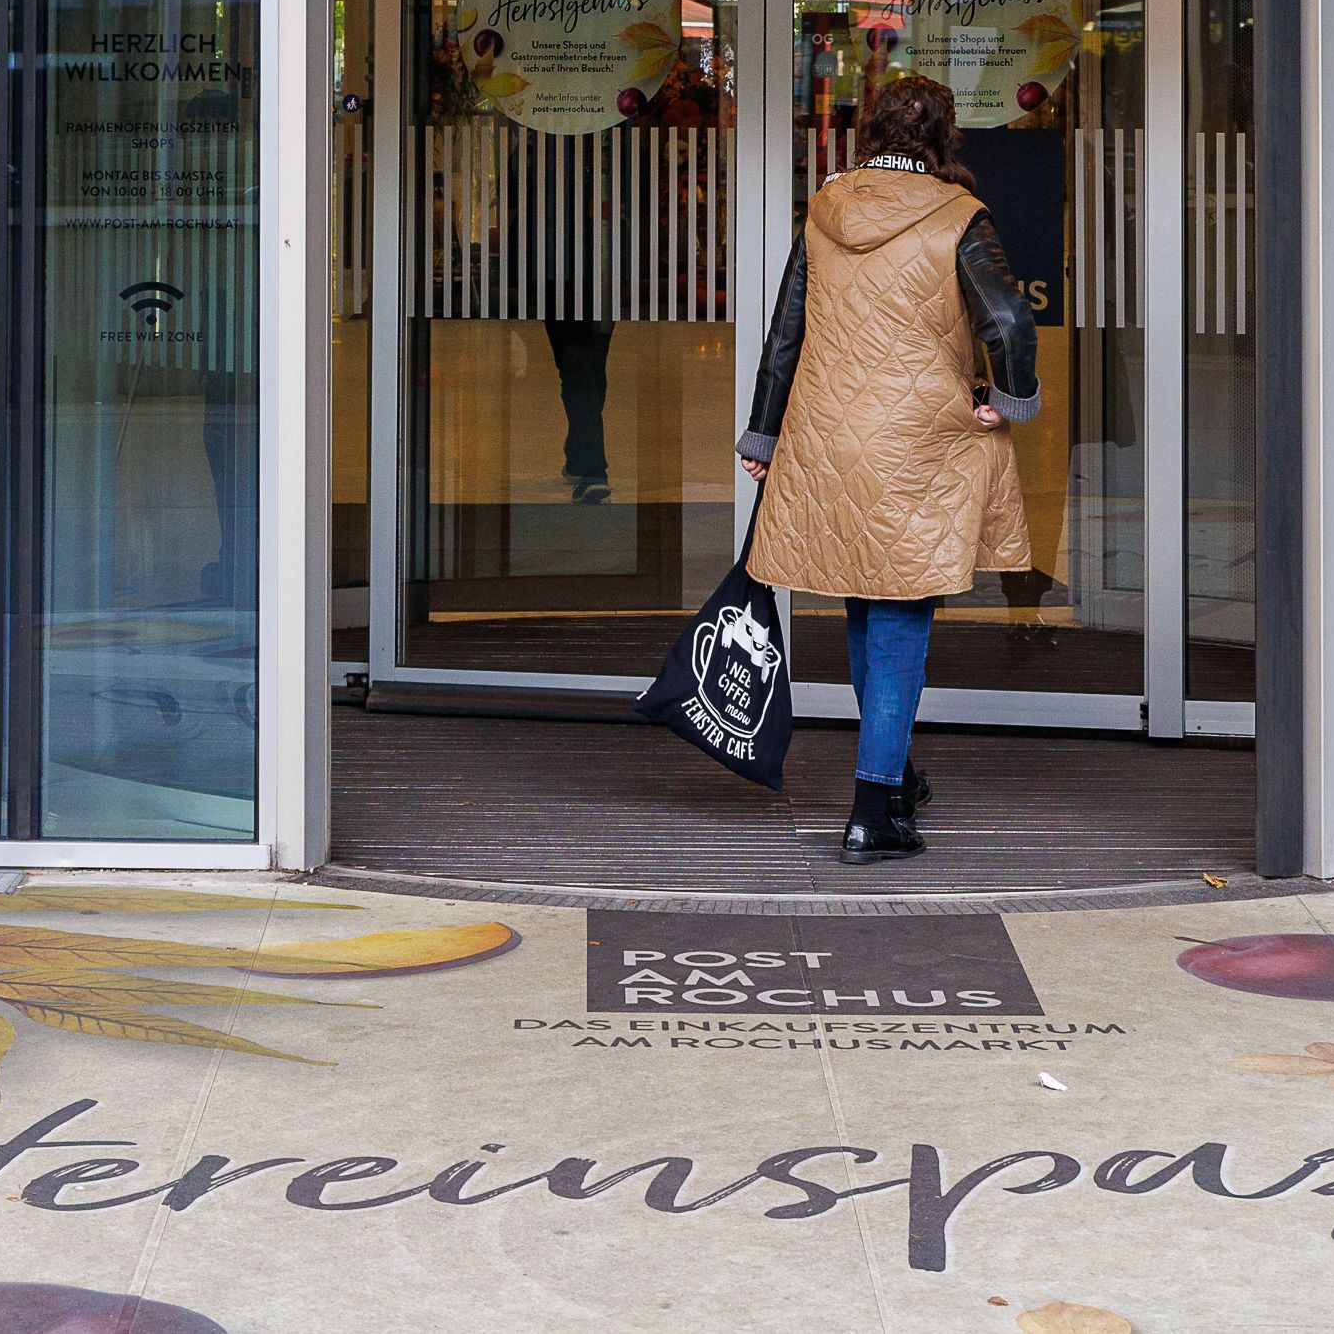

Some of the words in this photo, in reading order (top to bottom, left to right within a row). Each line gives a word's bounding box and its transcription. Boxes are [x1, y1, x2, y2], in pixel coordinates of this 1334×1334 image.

[90, 34, 216, 54] HERZLICH
[531, 41, 560, 50] Unsere
[563, 40, 587, 52] Shops
[589, 40, 606, 50] und
[927, 34, 957, 44] Unsere
[959, 34, 985, 46] Shops
[987, 34, 1005, 44] und
[905, 45, 996, 56] Gastronomiebetriebe
[998, 46, 1027, 56] freuen
[511, 52, 597, 62] Gastronomiebetriebe
[599, 52, 627, 62] freuen
[918, 57, 936, 68] sich
[938, 57, 952, 68] auf
[954, 57, 977, 68] Ihren
[979, 57, 1014, 68] Besuch!
[65, 62, 241, 82] WILLKOMMEN
[523, 63, 540, 73] sich
[542, 63, 555, 73] auf
[557, 63, 579, 73] Ihren
[581, 63, 614, 73] Besuch!
[536, 92, 556, 102] Mehr
[559, 92, 578, 102] Infos
[580, 93, 602, 102] unter
[956, 87, 977, 98] Infos
[978, 88, 1002, 98] unter
[532, 104, 605, 115] post-am-rochus.at
[954, 99, 1004, 109] m-rochus.at
[131, 138, 175, 149] SHOPS
[82, 170, 139, 181] MONTAG
[142, 170, 162, 181] BIS
[164, 170, 224, 181] SAMSTAG
[81, 186, 110, 197] VON
[114, 186, 147, 197] 10:00
[196, 186, 224, 197] UHR
[66, 218, 240, 230] WWW.POST-AM-ROCHUS.AT
[101, 332, 132, 342] FREE
[137, 332, 164, 342] WIFI
[168, 332, 204, 342] ZONE
[725, 703, 752, 726] meow
[681, 696, 725, 749] FENSTER
[727, 737, 756, 761] CAFÉ
[623, 950, 832, 968] POST
[616, 969, 754, 987] AM
[623, 987, 1003, 1008] ROCHUS
[513, 1018, 613, 1031] DAS
[629, 1018, 1127, 1035] EINKAUFSZENTRUM
[572, 1035, 652, 1048] AM
[670, 1036, 1074, 1051] ROCHUSMARKT
